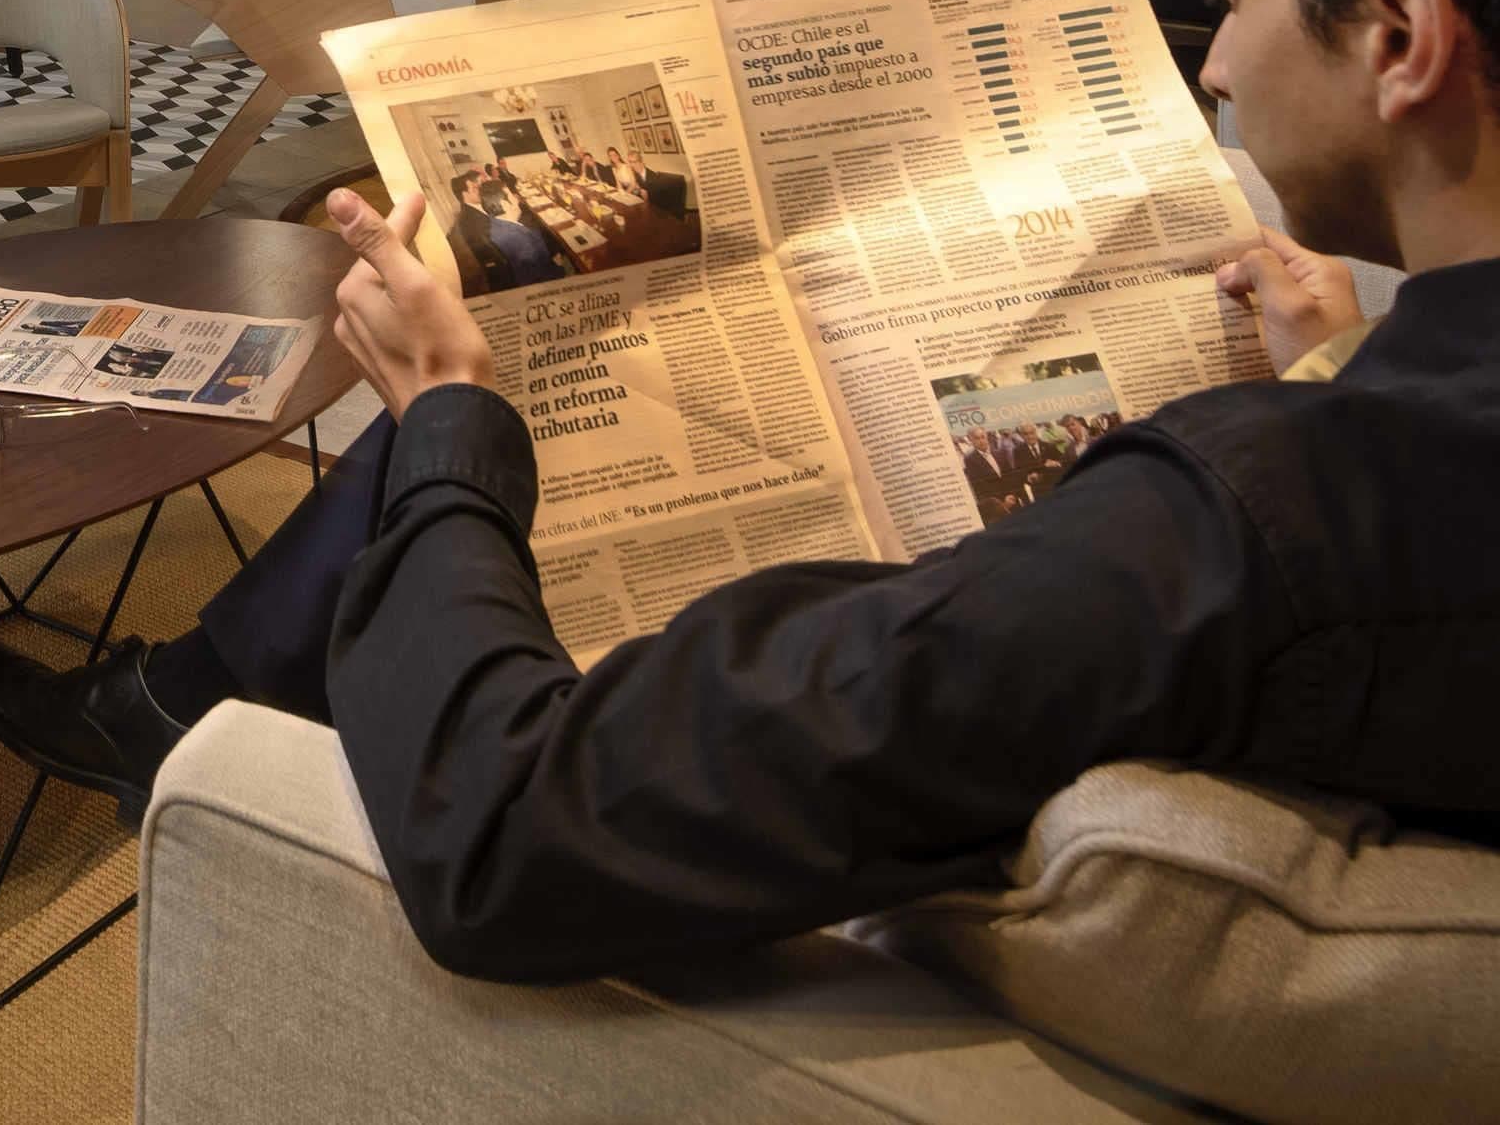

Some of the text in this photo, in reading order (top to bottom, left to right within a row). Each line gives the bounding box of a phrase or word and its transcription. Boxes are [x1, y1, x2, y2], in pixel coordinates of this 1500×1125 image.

[737, 32, 788, 52] OCDE:
[791, 25, 833, 45] Chile
[835, 27, 852, 42] es
[855, 19, 870, 35] el
[376, 56, 474, 86] ECONOMÍA
[742, 38, 884, 72] segundo país que
[747, 51, 919, 89] más subió impuesto a
[674, 90, 699, 116] 14
[752, 66, 933, 107] empresas desde el 2000
[1005, 205, 1075, 239] 2014
[525, 291, 621, 325] CPC se alinea
[821, 320, 885, 345] Gobierno
[887, 312, 928, 330] firma
[931, 300, 993, 326] proyecto
[994, 295, 1021, 312] pro
[1024, 277, 1112, 303] consumidor
[1114, 273, 1141, 290] con
[1142, 268, 1181, 285] cinco
[526, 309, 633, 348] con las PYME y
[528, 331, 649, 372] definen puntos
[529, 360, 610, 395] en común
[530, 384, 628, 418] en reforma
[532, 408, 620, 442] tributaria
[947, 410, 986, 429] PRO
[548, 517, 579, 538] cifras
[581, 510, 598, 530] del
[649, 502, 664, 515] un
[665, 488, 719, 514] problema
[720, 486, 741, 503] que
[743, 480, 763, 494] nos
[765, 471, 790, 491] hace
